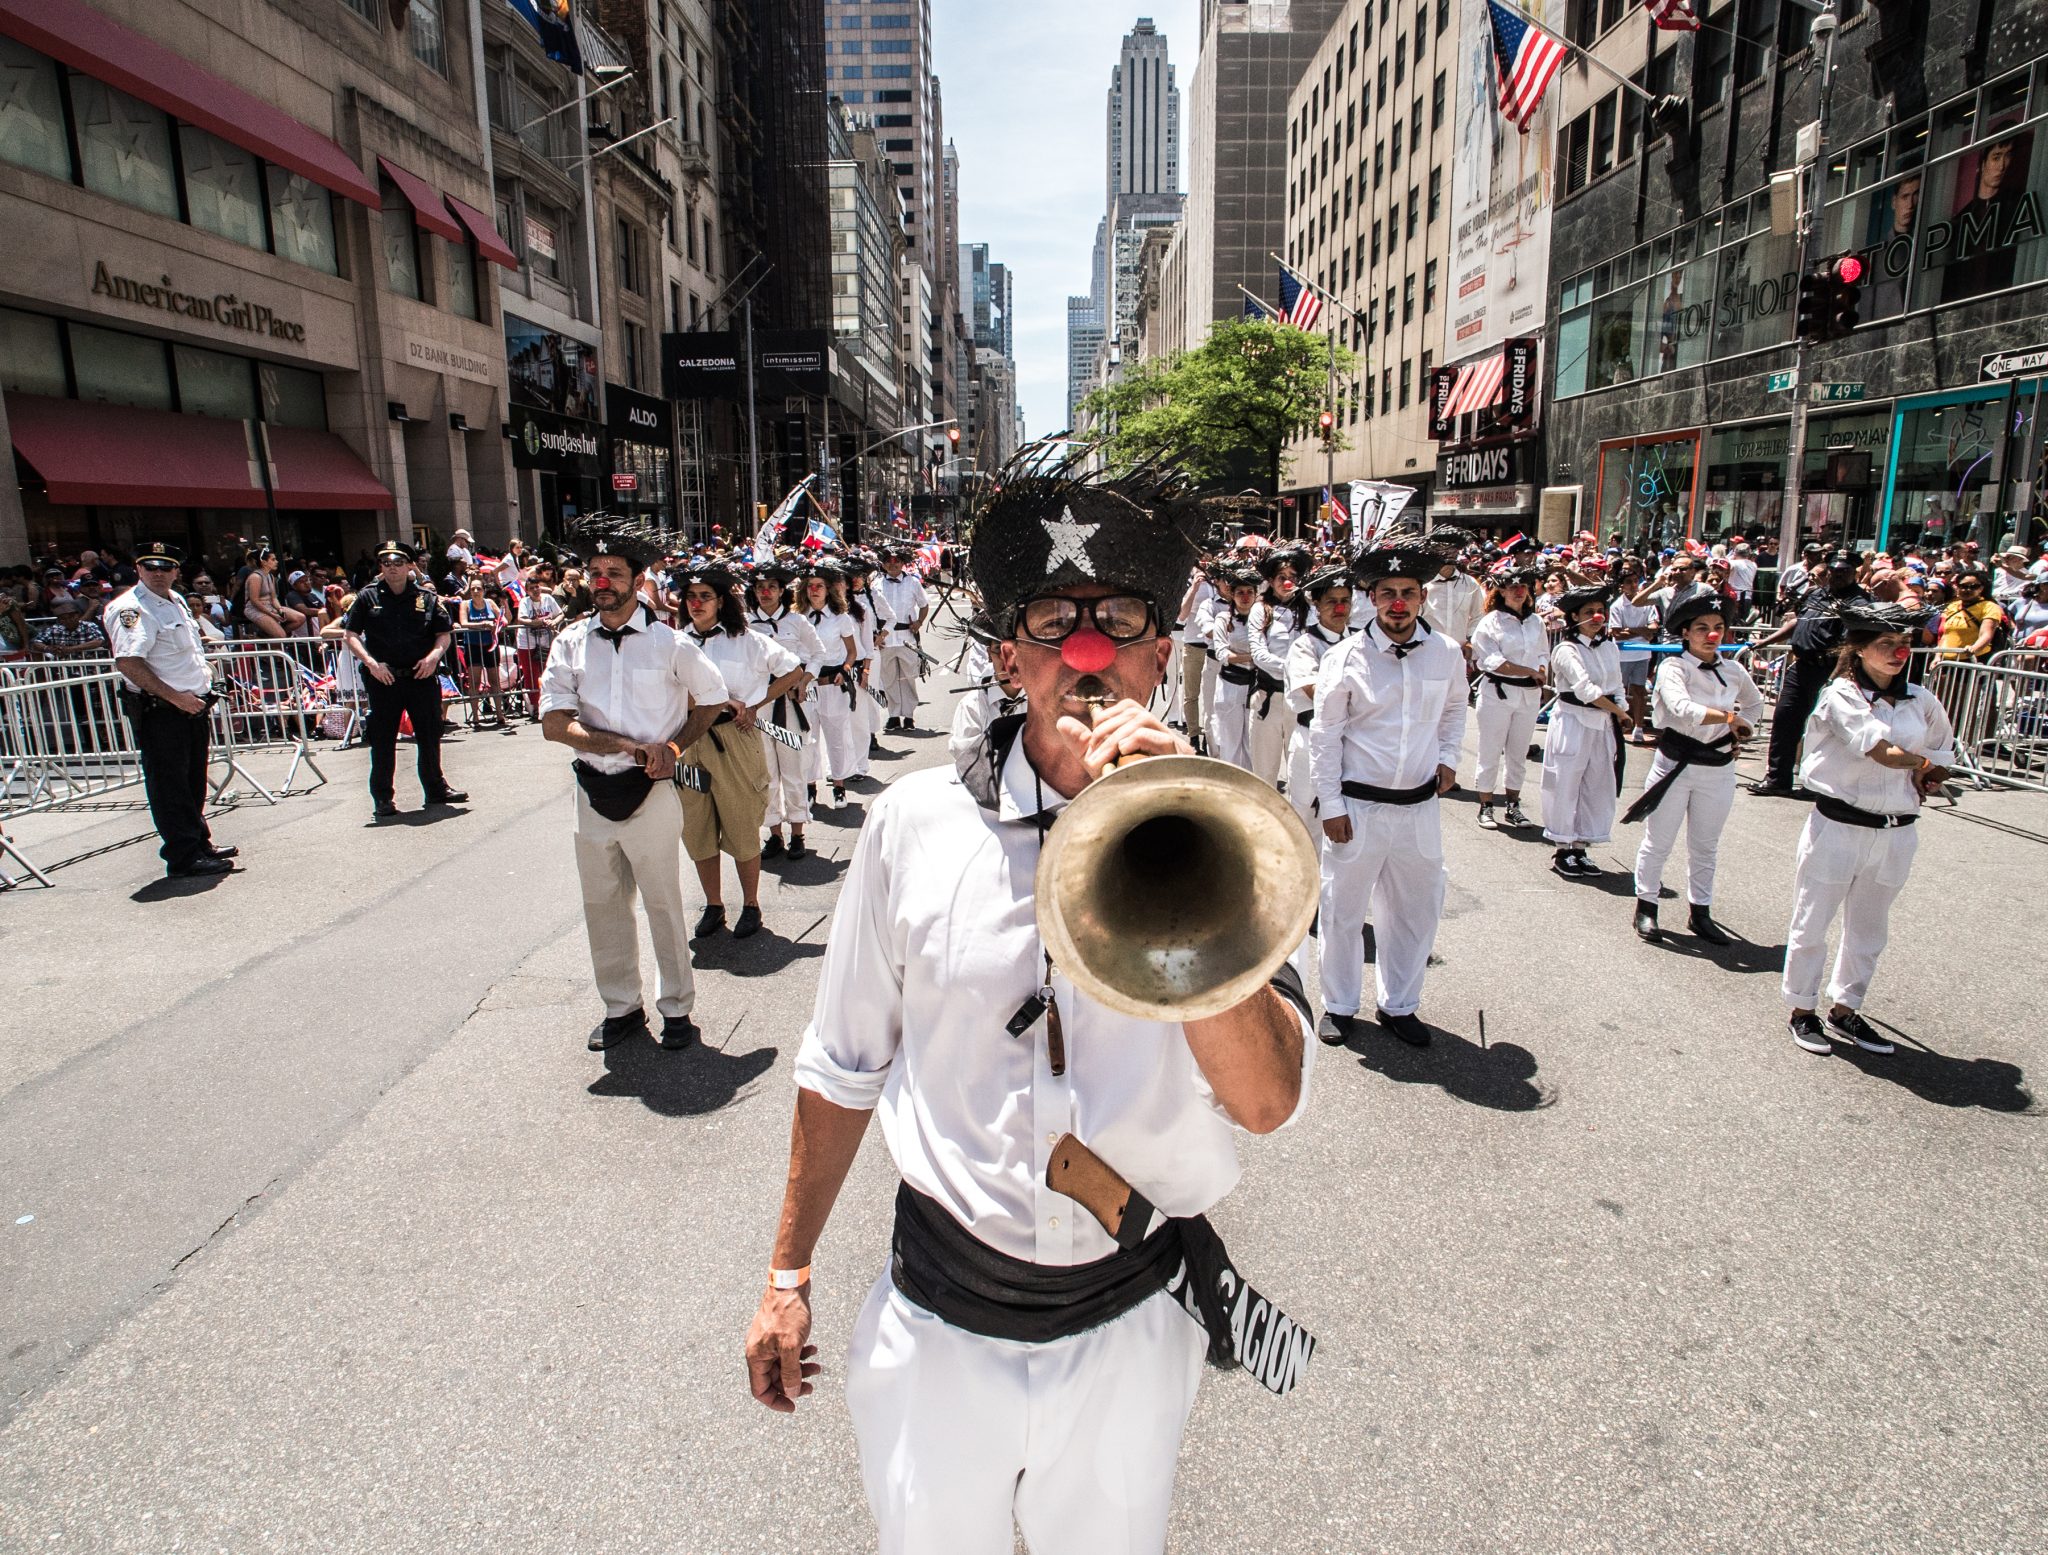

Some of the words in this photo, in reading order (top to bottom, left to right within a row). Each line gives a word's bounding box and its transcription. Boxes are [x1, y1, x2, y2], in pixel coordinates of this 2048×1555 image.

[1472, 209, 1487, 233] YOUR
[91, 260, 214, 322] American
[213, 294, 254, 332] Girl
[252, 303, 306, 343] Place
[1671, 272, 1798, 345] TOPSHOP
[410, 342, 423, 359] DZ
[424, 346, 449, 366] BANK
[450, 353, 488, 376] BUILDING
[679, 358, 736, 367] CALZEDONIA
[1991, 360, 2012, 373] ONE
[2021, 353, 2045, 368] WAY
[1511, 355, 1526, 414] FRIDAYS
[1773, 375, 1780, 389] 5
[1781, 374, 1788, 382] AV
[1822, 386, 1831, 399] W
[1835, 385, 1851, 398] 49
[1853, 385, 1862, 393] ST
[629, 406, 657, 428] ALDO
[541, 429, 582, 457] sunglass
[581, 432, 598, 456] hut
[1452, 447, 1508, 484] FRIDAYS
